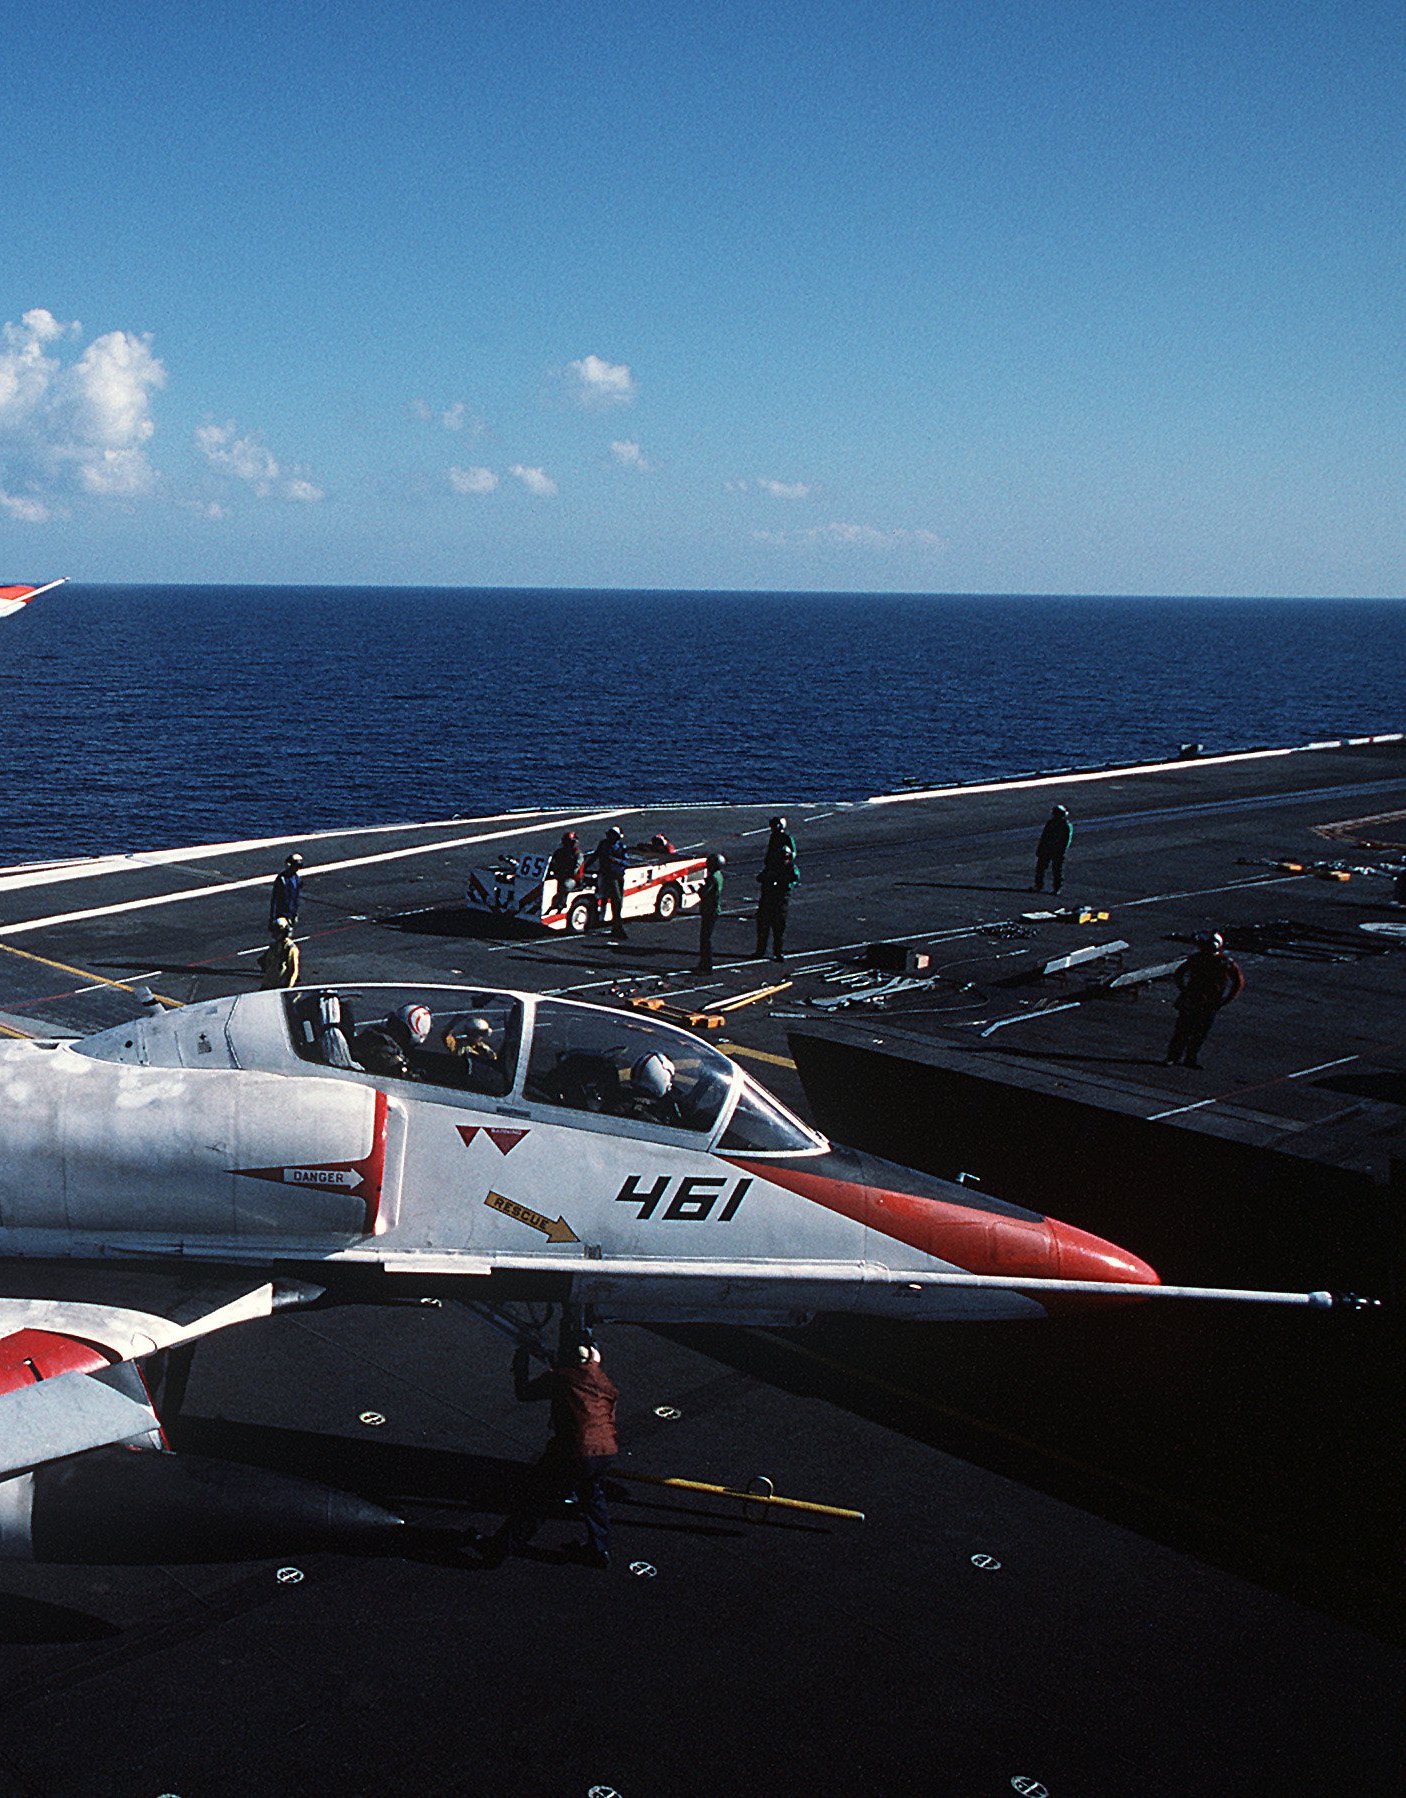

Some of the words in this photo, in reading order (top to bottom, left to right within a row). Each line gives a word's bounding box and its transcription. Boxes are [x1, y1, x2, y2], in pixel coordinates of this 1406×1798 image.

[293, 1170, 345, 1183] DANGER
[493, 1198, 551, 1231] RESCUE
[615, 1175, 754, 1222] 461
